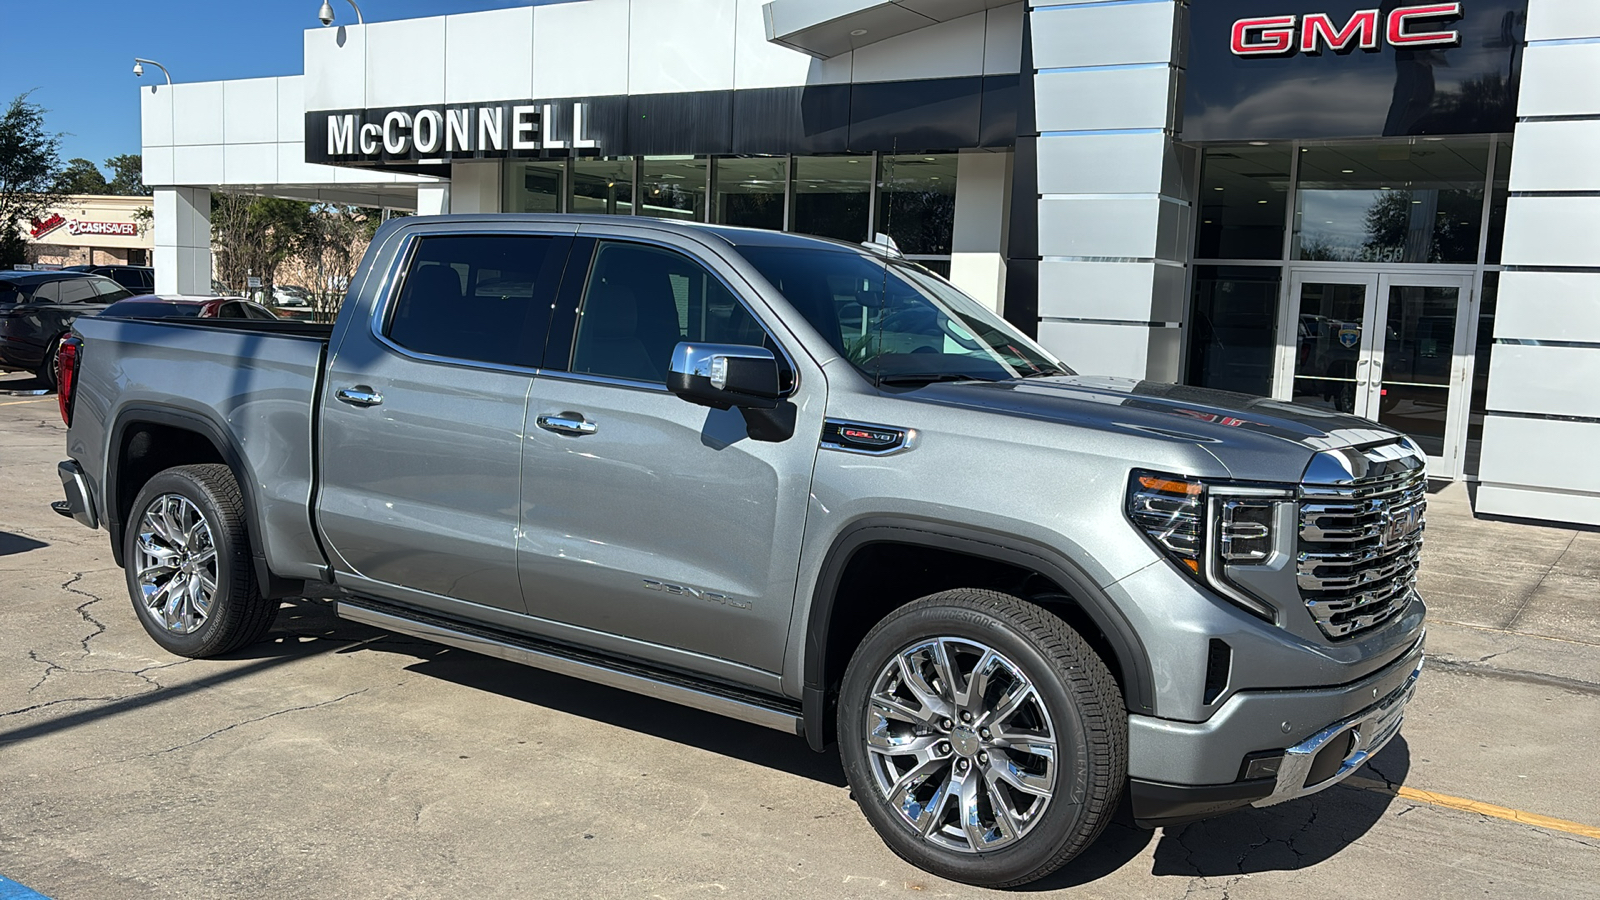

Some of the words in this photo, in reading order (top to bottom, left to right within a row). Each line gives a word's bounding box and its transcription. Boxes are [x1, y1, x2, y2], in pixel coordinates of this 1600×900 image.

[1230, 2, 1463, 55] GMC
[327, 102, 598, 155] McCONNELL
[80, 223, 134, 234] CASHSAVER
[643, 579, 752, 611] DENALI
[921, 609, 997, 630] BRIDGESTONE
